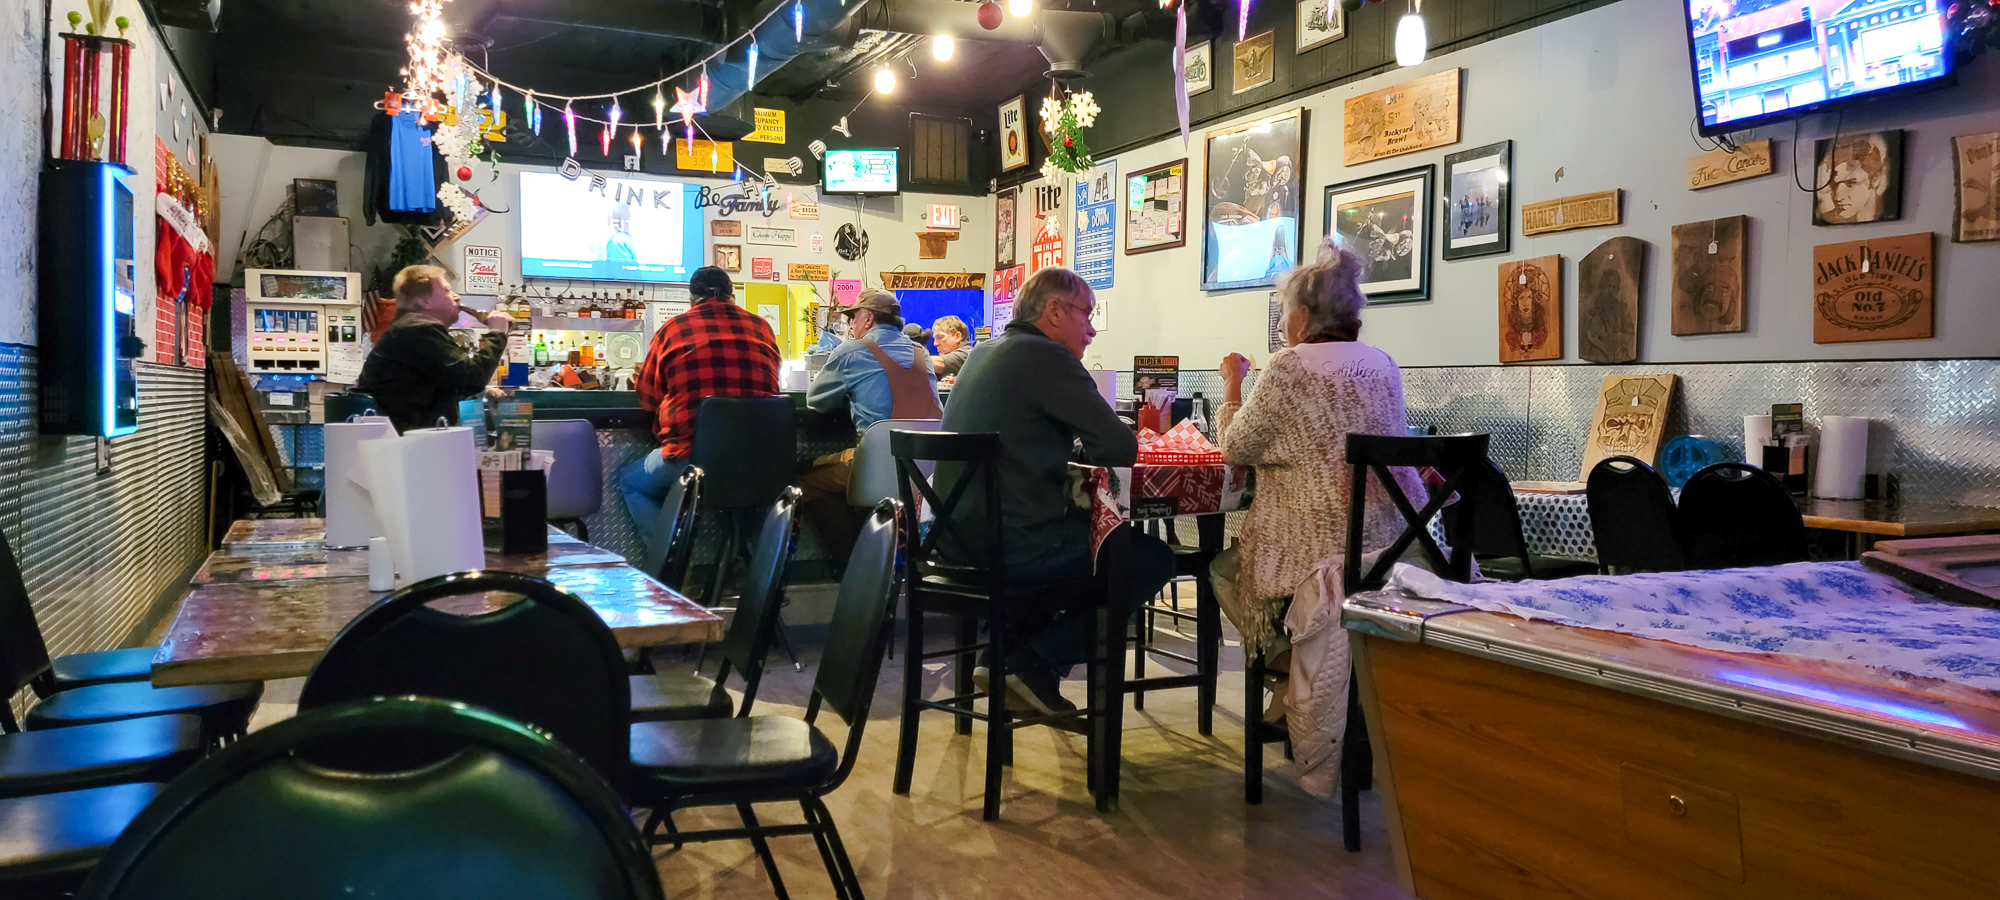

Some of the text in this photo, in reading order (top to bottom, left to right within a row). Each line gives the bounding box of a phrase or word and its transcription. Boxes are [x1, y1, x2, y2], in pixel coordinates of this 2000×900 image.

[1004, 110, 1018, 129] Lite
[1384, 125, 1414, 137] Backyard
[1387, 135, 1407, 145] Brawl
[1727, 154, 1767, 174] Cancer
[560, 157, 671, 209] DRINK
[694, 186, 720, 210] Be
[719, 193, 780, 217] Family
[1035, 185, 1062, 220] Lite
[932, 204, 956, 226] EXIT
[1526, 198, 1611, 230] HARLEY DAVIDSON
[771, 230, 791, 241] Happy
[468, 248, 498, 256] NOTICE
[1043, 242, 1052, 251] THE
[470, 263, 497, 273] Fast
[1817, 246, 1927, 285] JACK DANIEL'S
[890, 274, 973, 289] RESTROOMS
[1845, 272, 1894, 283] OLD TIME
[1855, 291, 1883, 302] Old
